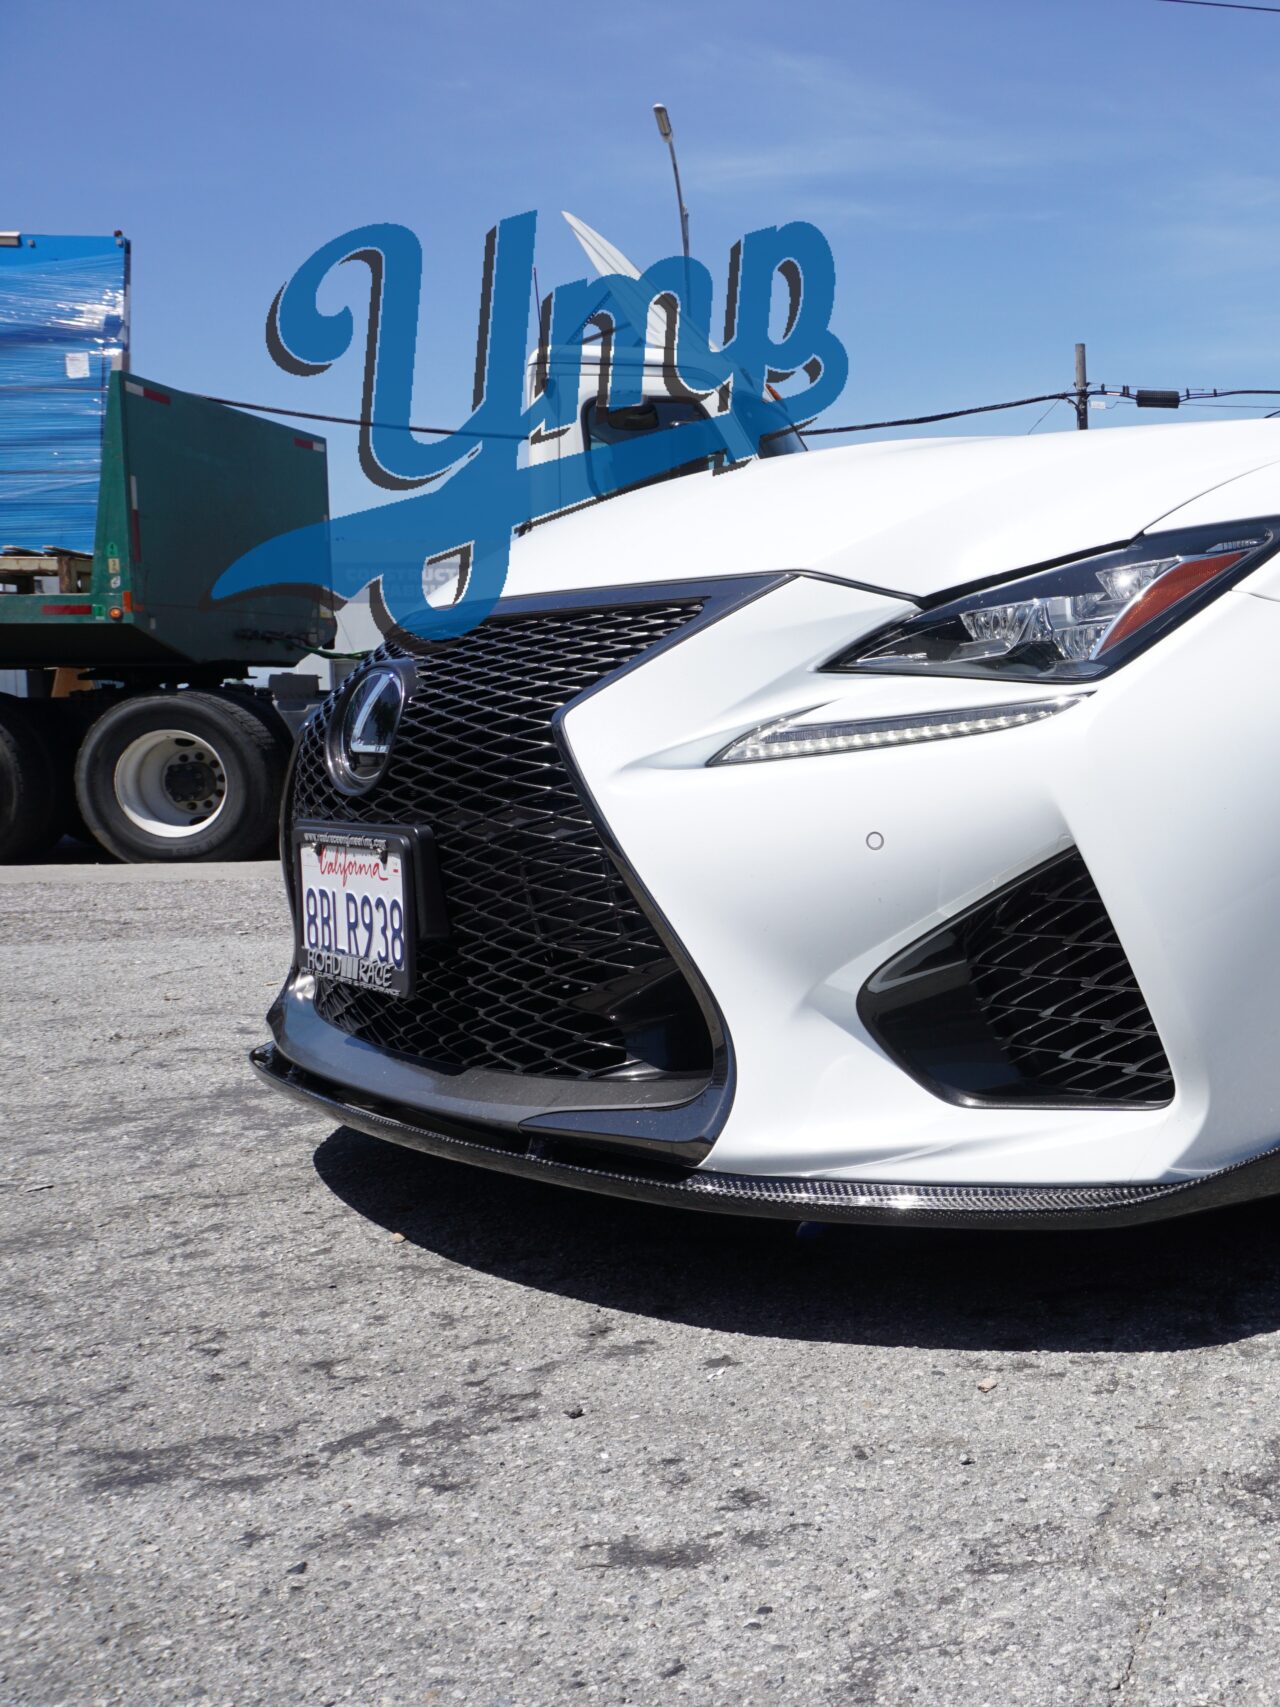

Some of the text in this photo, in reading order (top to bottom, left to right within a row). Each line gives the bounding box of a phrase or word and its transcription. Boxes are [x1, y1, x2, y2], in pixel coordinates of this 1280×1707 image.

[319, 845, 389, 888] California
[306, 887, 405, 970] 8BLR938
[307, 949, 341, 975] ROAD
[359, 958, 396, 987] RACE
